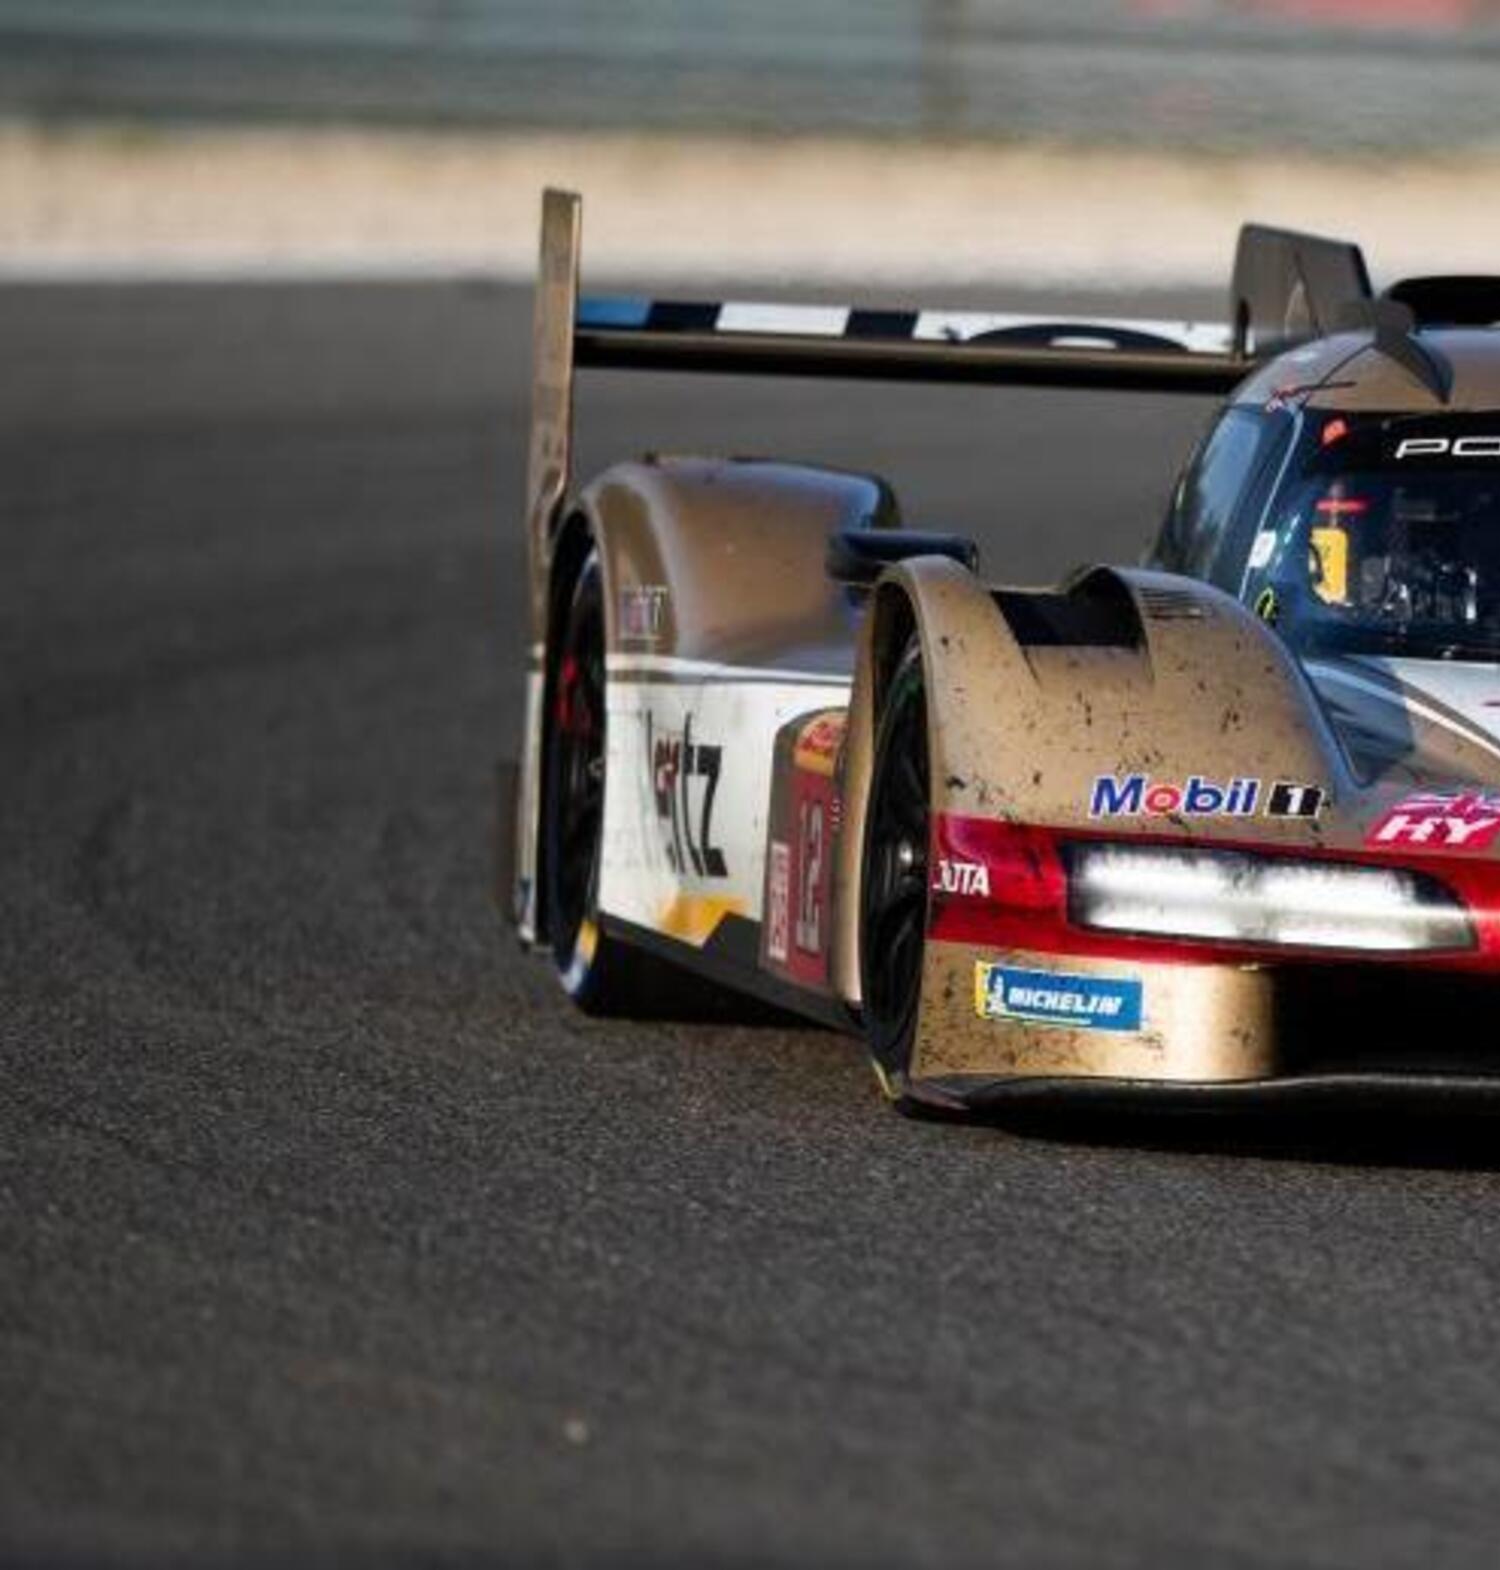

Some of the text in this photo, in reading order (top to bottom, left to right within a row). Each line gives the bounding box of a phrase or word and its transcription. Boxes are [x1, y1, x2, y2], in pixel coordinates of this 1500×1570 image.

[1092, 776, 1258, 816] Mobil
[1375, 814, 1499, 845] HY
[1007, 986, 1123, 1016] MICHELIN
